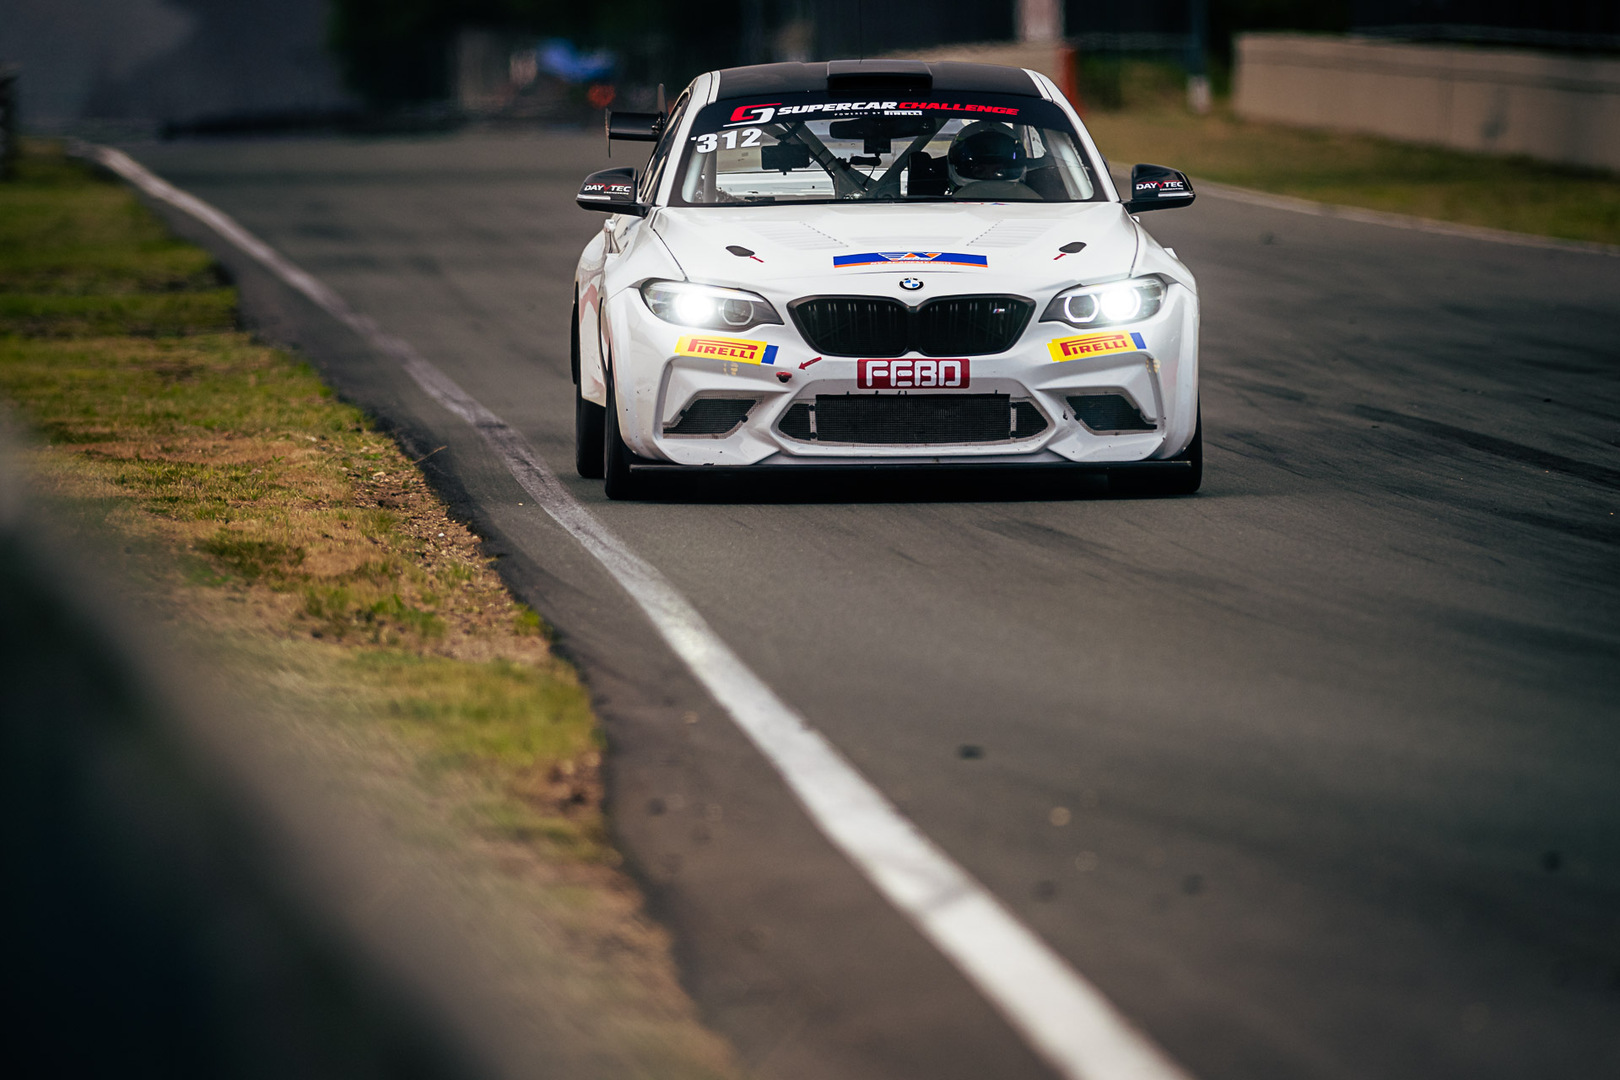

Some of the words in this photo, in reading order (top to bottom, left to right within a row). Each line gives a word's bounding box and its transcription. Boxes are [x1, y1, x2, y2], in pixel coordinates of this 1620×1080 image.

[777, 101, 898, 116] SUPERCAR
[898, 101, 1020, 116] CHALLENGE
[696, 128, 763, 154] 312
[687, 339, 759, 360] PIRELLI
[1060, 334, 1128, 357] PIRELLI
[865, 360, 962, 387] FEBO
